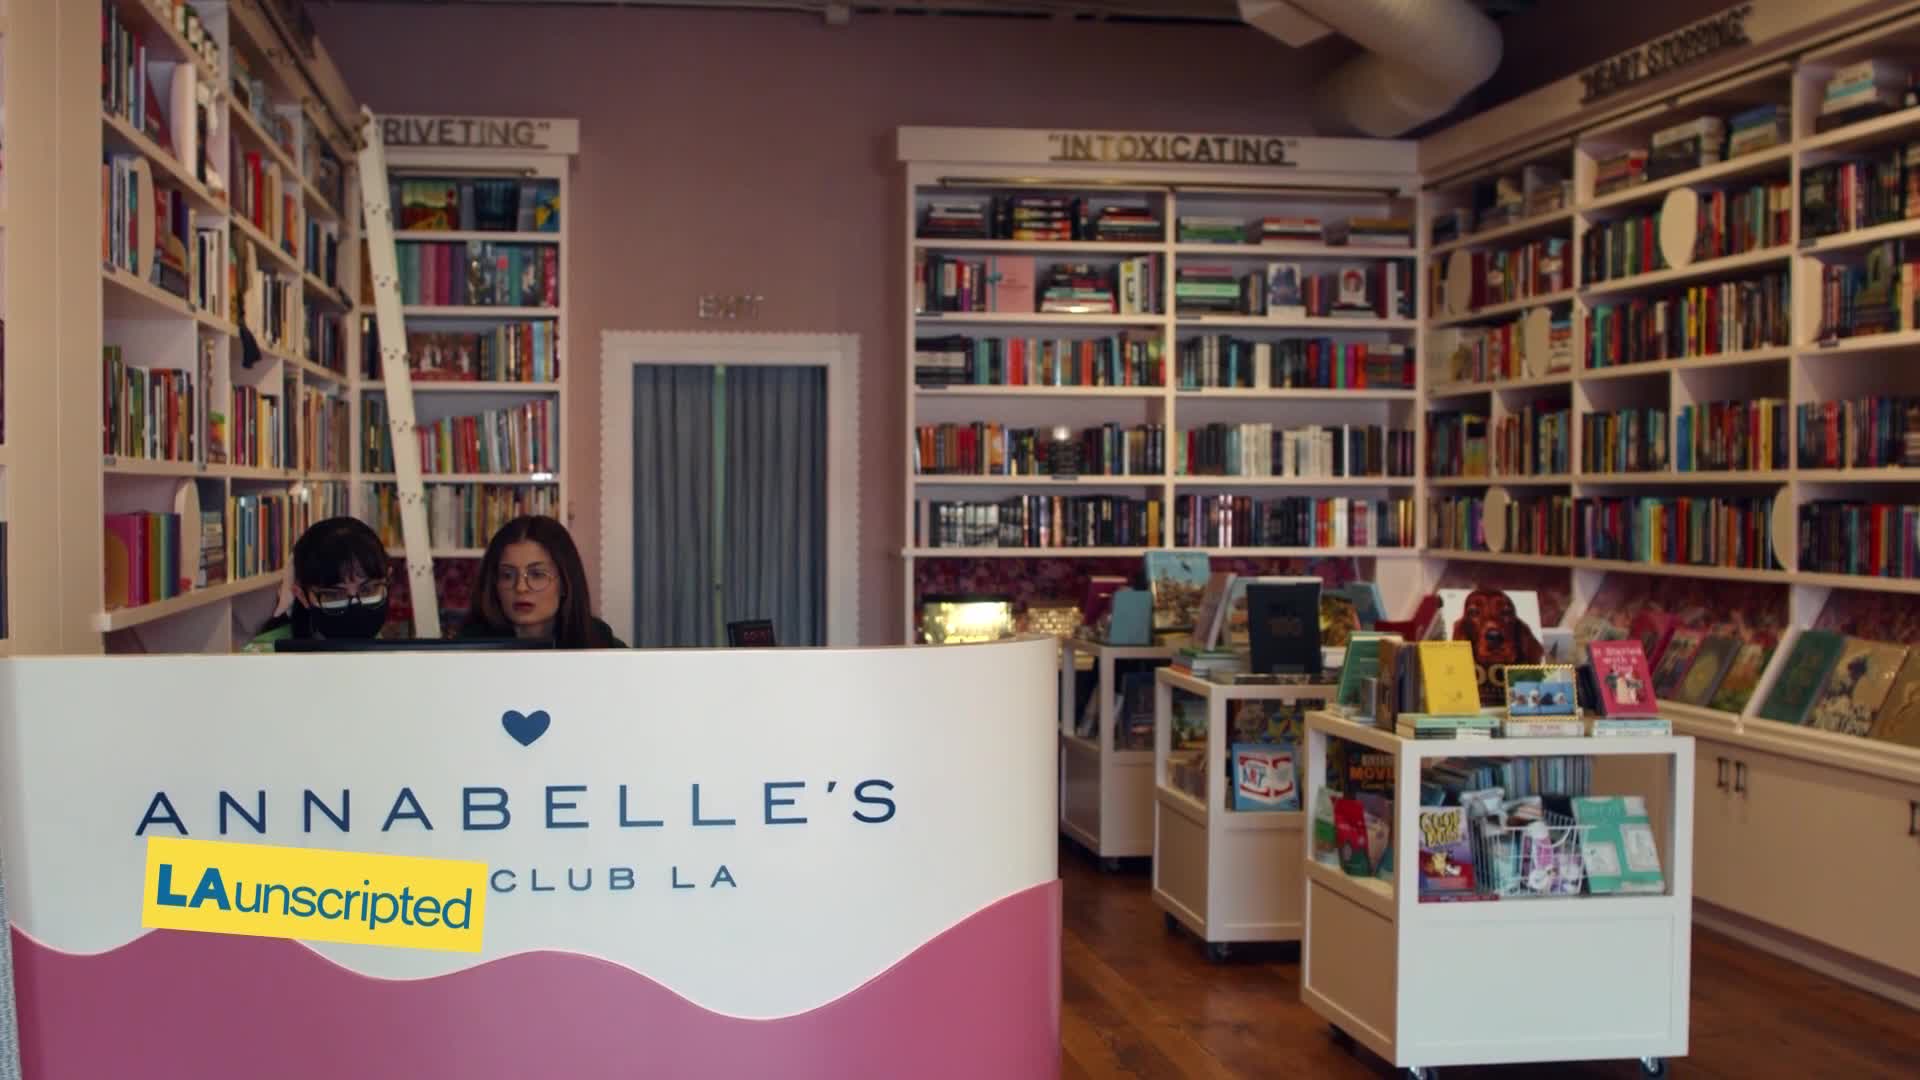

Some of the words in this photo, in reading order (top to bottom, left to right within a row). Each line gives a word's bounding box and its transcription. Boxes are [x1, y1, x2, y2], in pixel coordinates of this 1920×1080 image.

[135, 779, 896, 836] ANNABELLE'S
[490, 866, 636, 893] CLUB
[671, 864, 738, 889] LA
